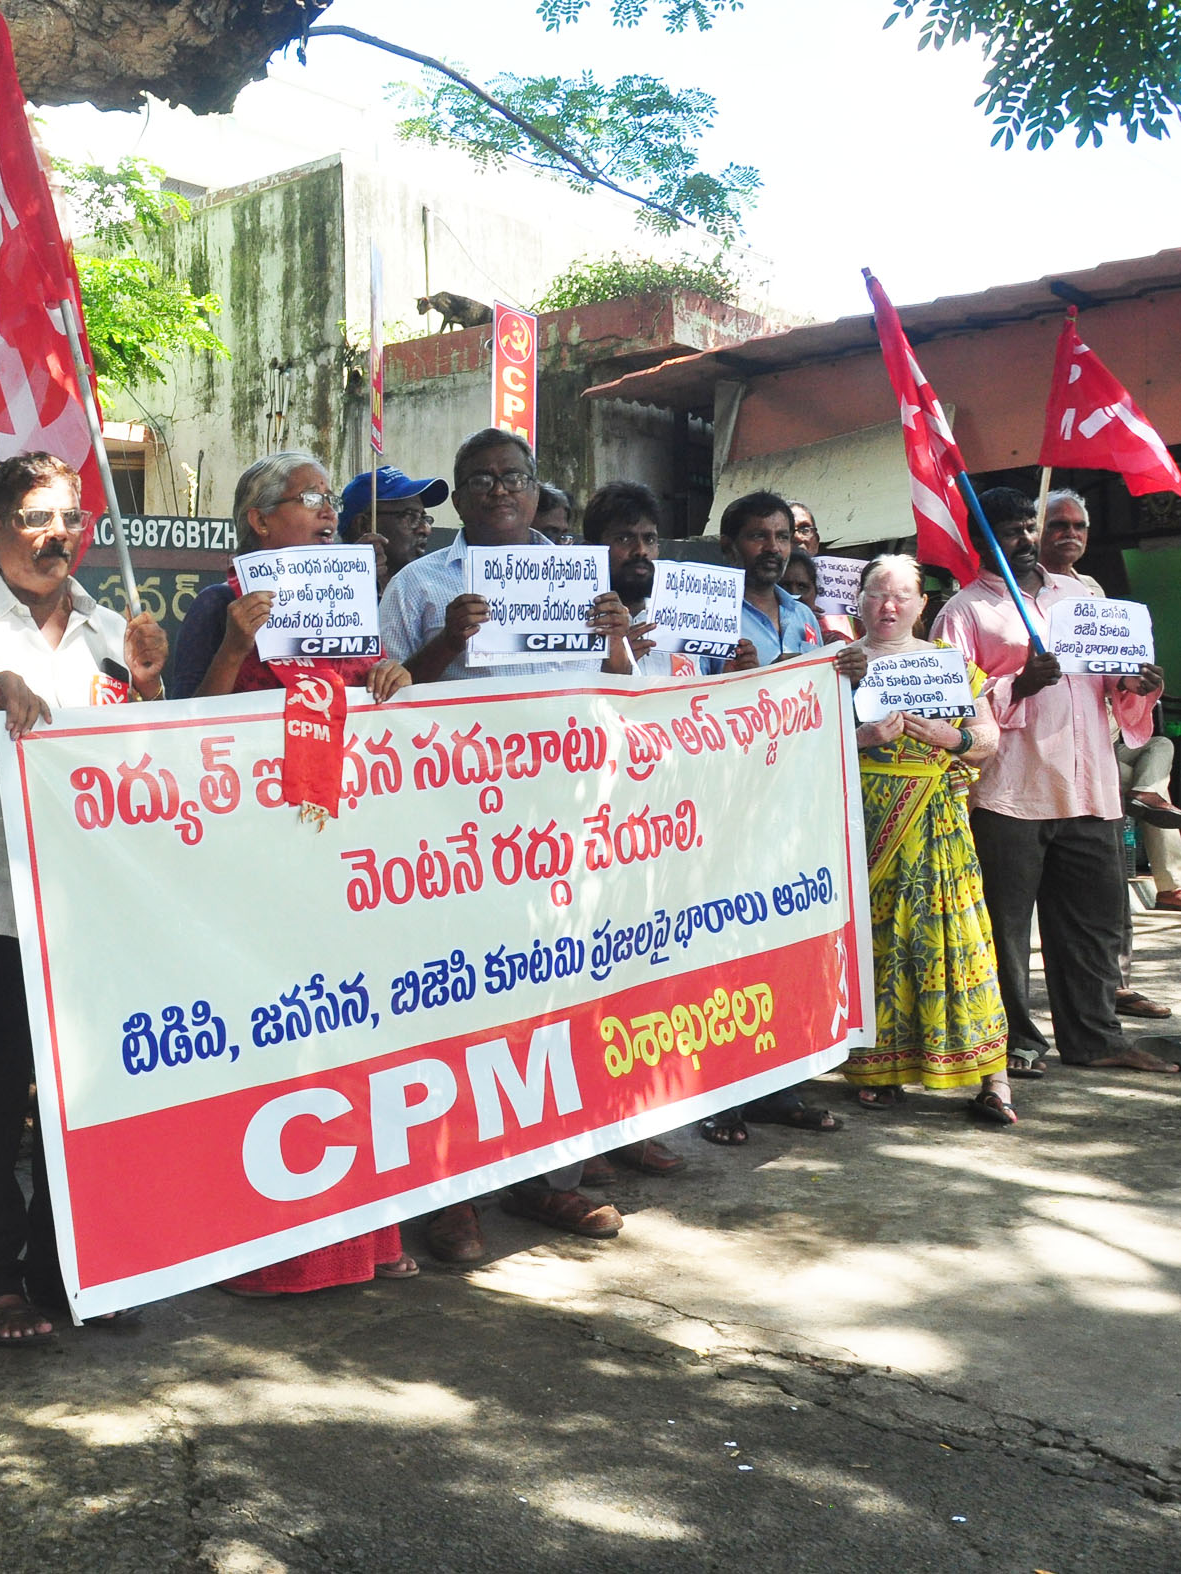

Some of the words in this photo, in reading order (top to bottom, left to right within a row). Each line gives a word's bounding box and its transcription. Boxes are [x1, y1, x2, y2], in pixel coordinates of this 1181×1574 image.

[249, 558, 285, 581] విద్యుత్
[288, 558, 321, 576] ఇంధన
[484, 554, 513, 589] విద్యుత్
[515, 557, 539, 584] ధరలు
[279, 586, 295, 606] ట్రూ
[297, 583, 313, 601] అప్
[509, 603, 541, 624] భారాలు
[543, 595, 575, 621] వేయడం
[266, 610, 301, 629] వెంటనే
[303, 612, 323, 635] రద్దు
[325, 609, 363, 628] చేయాలి.
[300, 637, 363, 654] CPM
[527, 634, 588, 650] CPM
[685, 640, 730, 656] CPM
[1089, 661, 1140, 673] CPM
[887, 674, 921, 687] కూటమి
[924, 672, 963, 685] పాలనకు
[880, 691, 901, 705] తేడా
[287, 719, 331, 742] CPM
[70, 736, 240, 846] విద్యుత్
[253, 729, 402, 810] ఇధన
[619, 715, 672, 781] ట్రూ
[672, 694, 725, 755] అప్
[724, 681, 822, 766] ఛార్జీలను
[341, 821, 483, 911] వెంటనే
[492, 818, 574, 906] రద్దు
[584, 799, 703, 871] చేయాలి.
[122, 1000, 240, 1075] టిడిపి,
[251, 971, 380, 1048] జనసేన,
[391, 949, 477, 1015] బిజెపి
[484, 936, 585, 994] కూటమి
[590, 909, 670, 981] ప్రజలపై
[674, 890, 768, 950] భారాలు
[773, 866, 839, 916] ఆపాలి.
[242, 1019, 583, 1202] CPM
